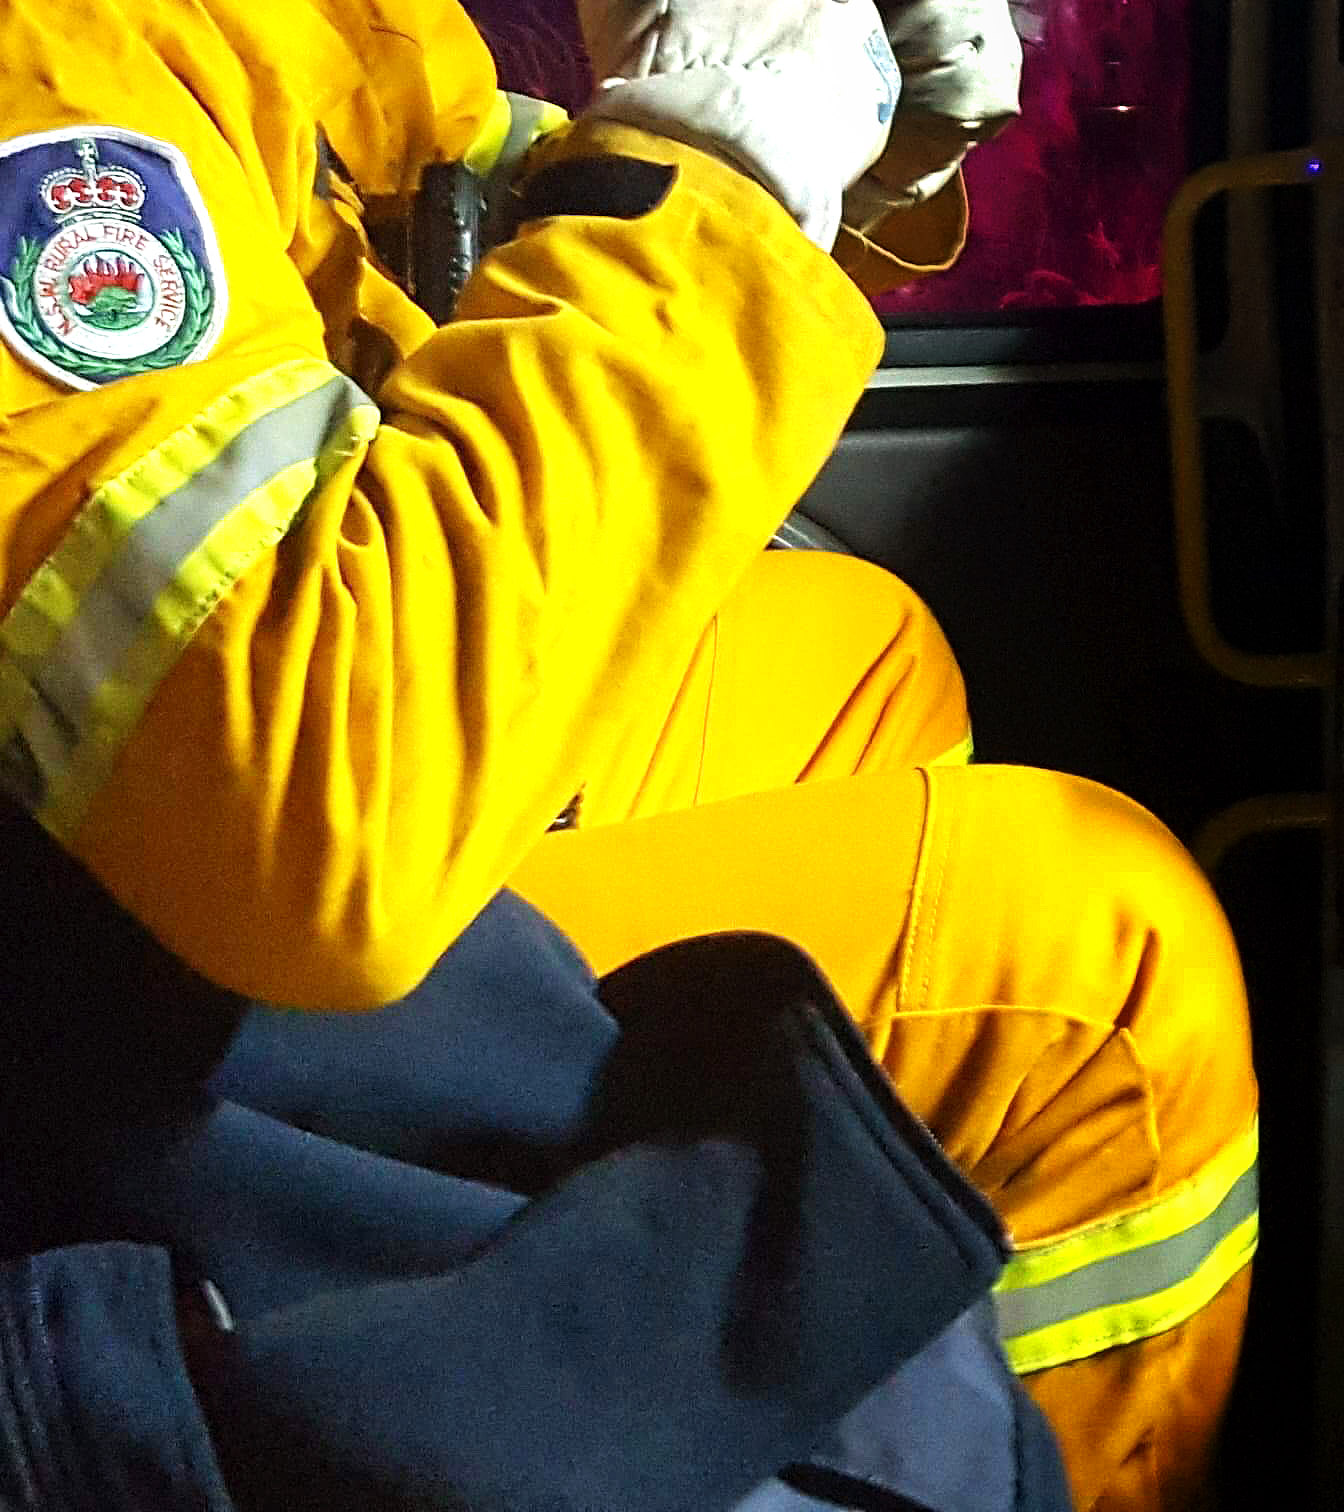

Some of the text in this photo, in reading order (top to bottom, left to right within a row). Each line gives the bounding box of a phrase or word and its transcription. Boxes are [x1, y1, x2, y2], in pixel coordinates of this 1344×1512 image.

[45, 226, 97, 273] RURAL
[103, 224, 151, 251] FIRE
[152, 253, 184, 333] SERVICE
